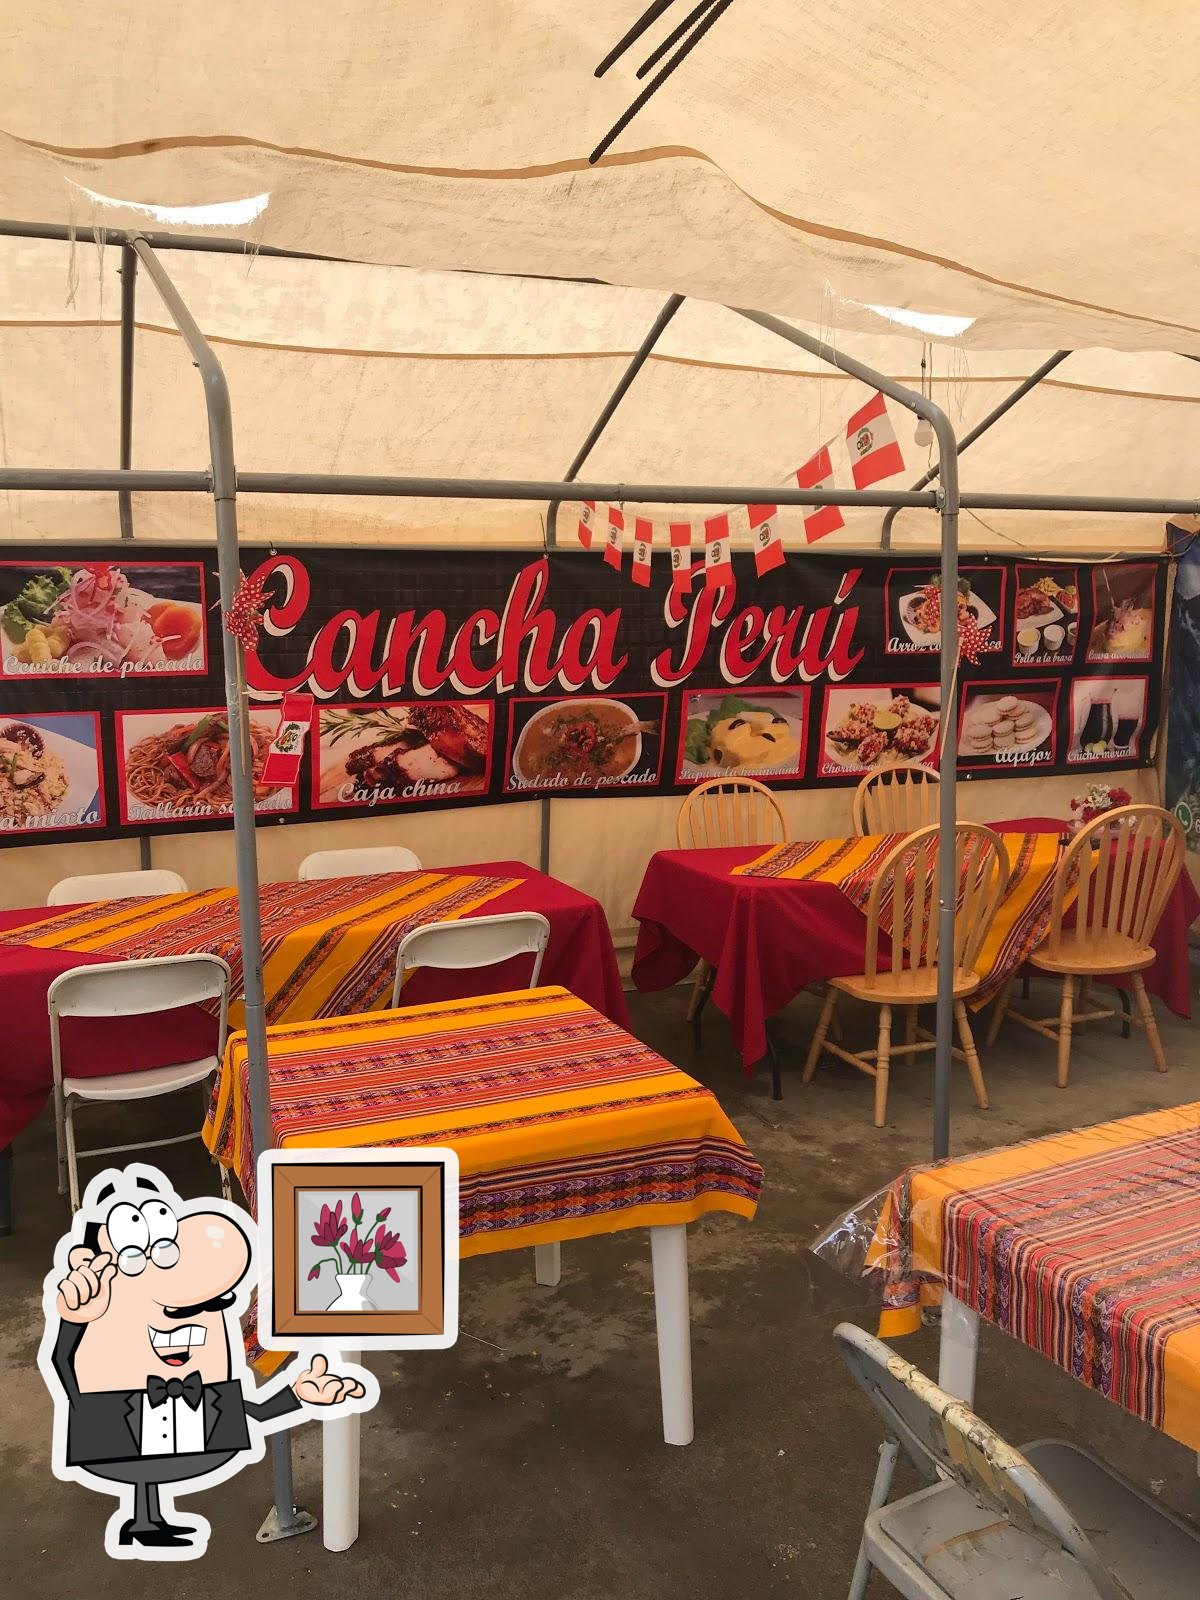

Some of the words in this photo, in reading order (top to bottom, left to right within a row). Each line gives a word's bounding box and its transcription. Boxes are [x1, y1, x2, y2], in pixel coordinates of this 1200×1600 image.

[246, 555, 629, 701] Cancha
[651, 560, 865, 687] Perú
[888, 637, 928, 652] Arroz
[89, 655, 116, 673] de
[120, 653, 204, 678] pescado
[1014, 653, 1034, 664] Pollo
[1043, 652, 1052, 663] la
[1053, 652, 1073, 662] brasa
[995, 748, 1053, 767] Alfajor
[507, 772, 569, 790] Sudado
[574, 771, 592, 786] de
[595, 768, 657, 789] pescado
[338, 783, 396, 807] Caja
[402, 778, 461, 798] china
[25, 807, 101, 828] mixto
